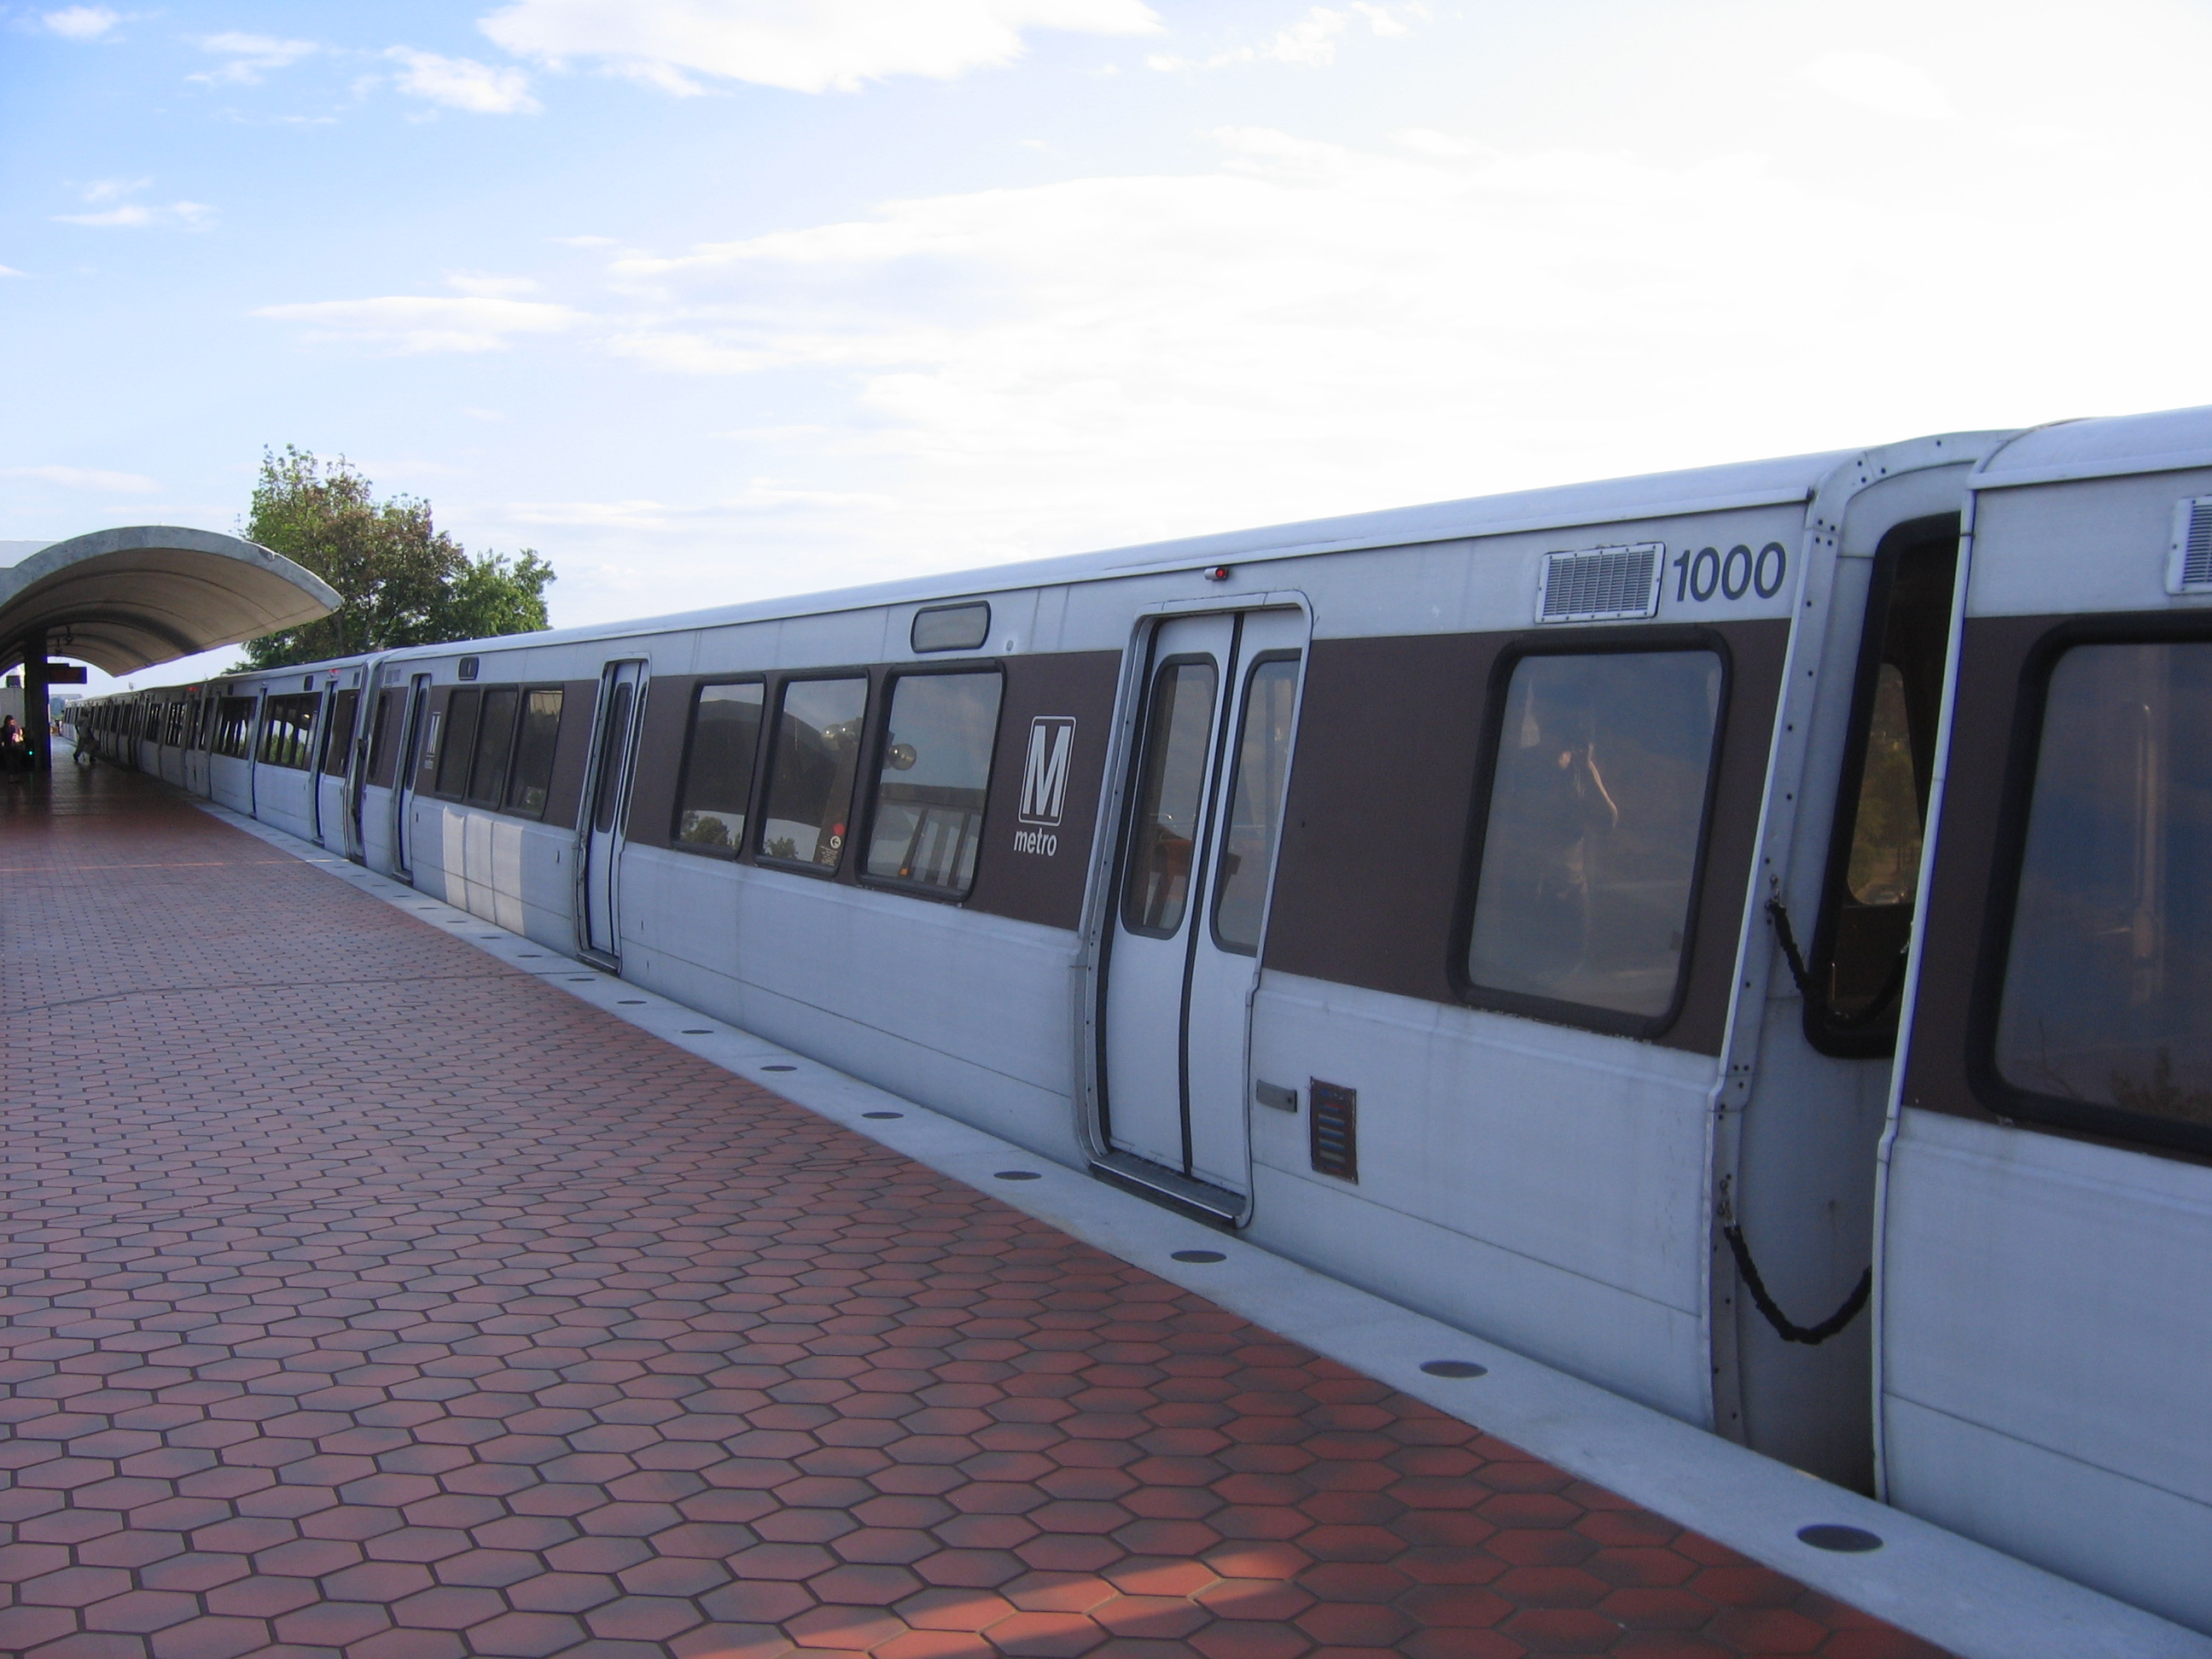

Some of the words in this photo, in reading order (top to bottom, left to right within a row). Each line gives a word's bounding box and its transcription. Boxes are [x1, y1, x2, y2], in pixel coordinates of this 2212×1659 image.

[1674, 542, 1786, 602] 1000
[1022, 725, 1072, 817] M
[1014, 828, 1057, 856] metro
